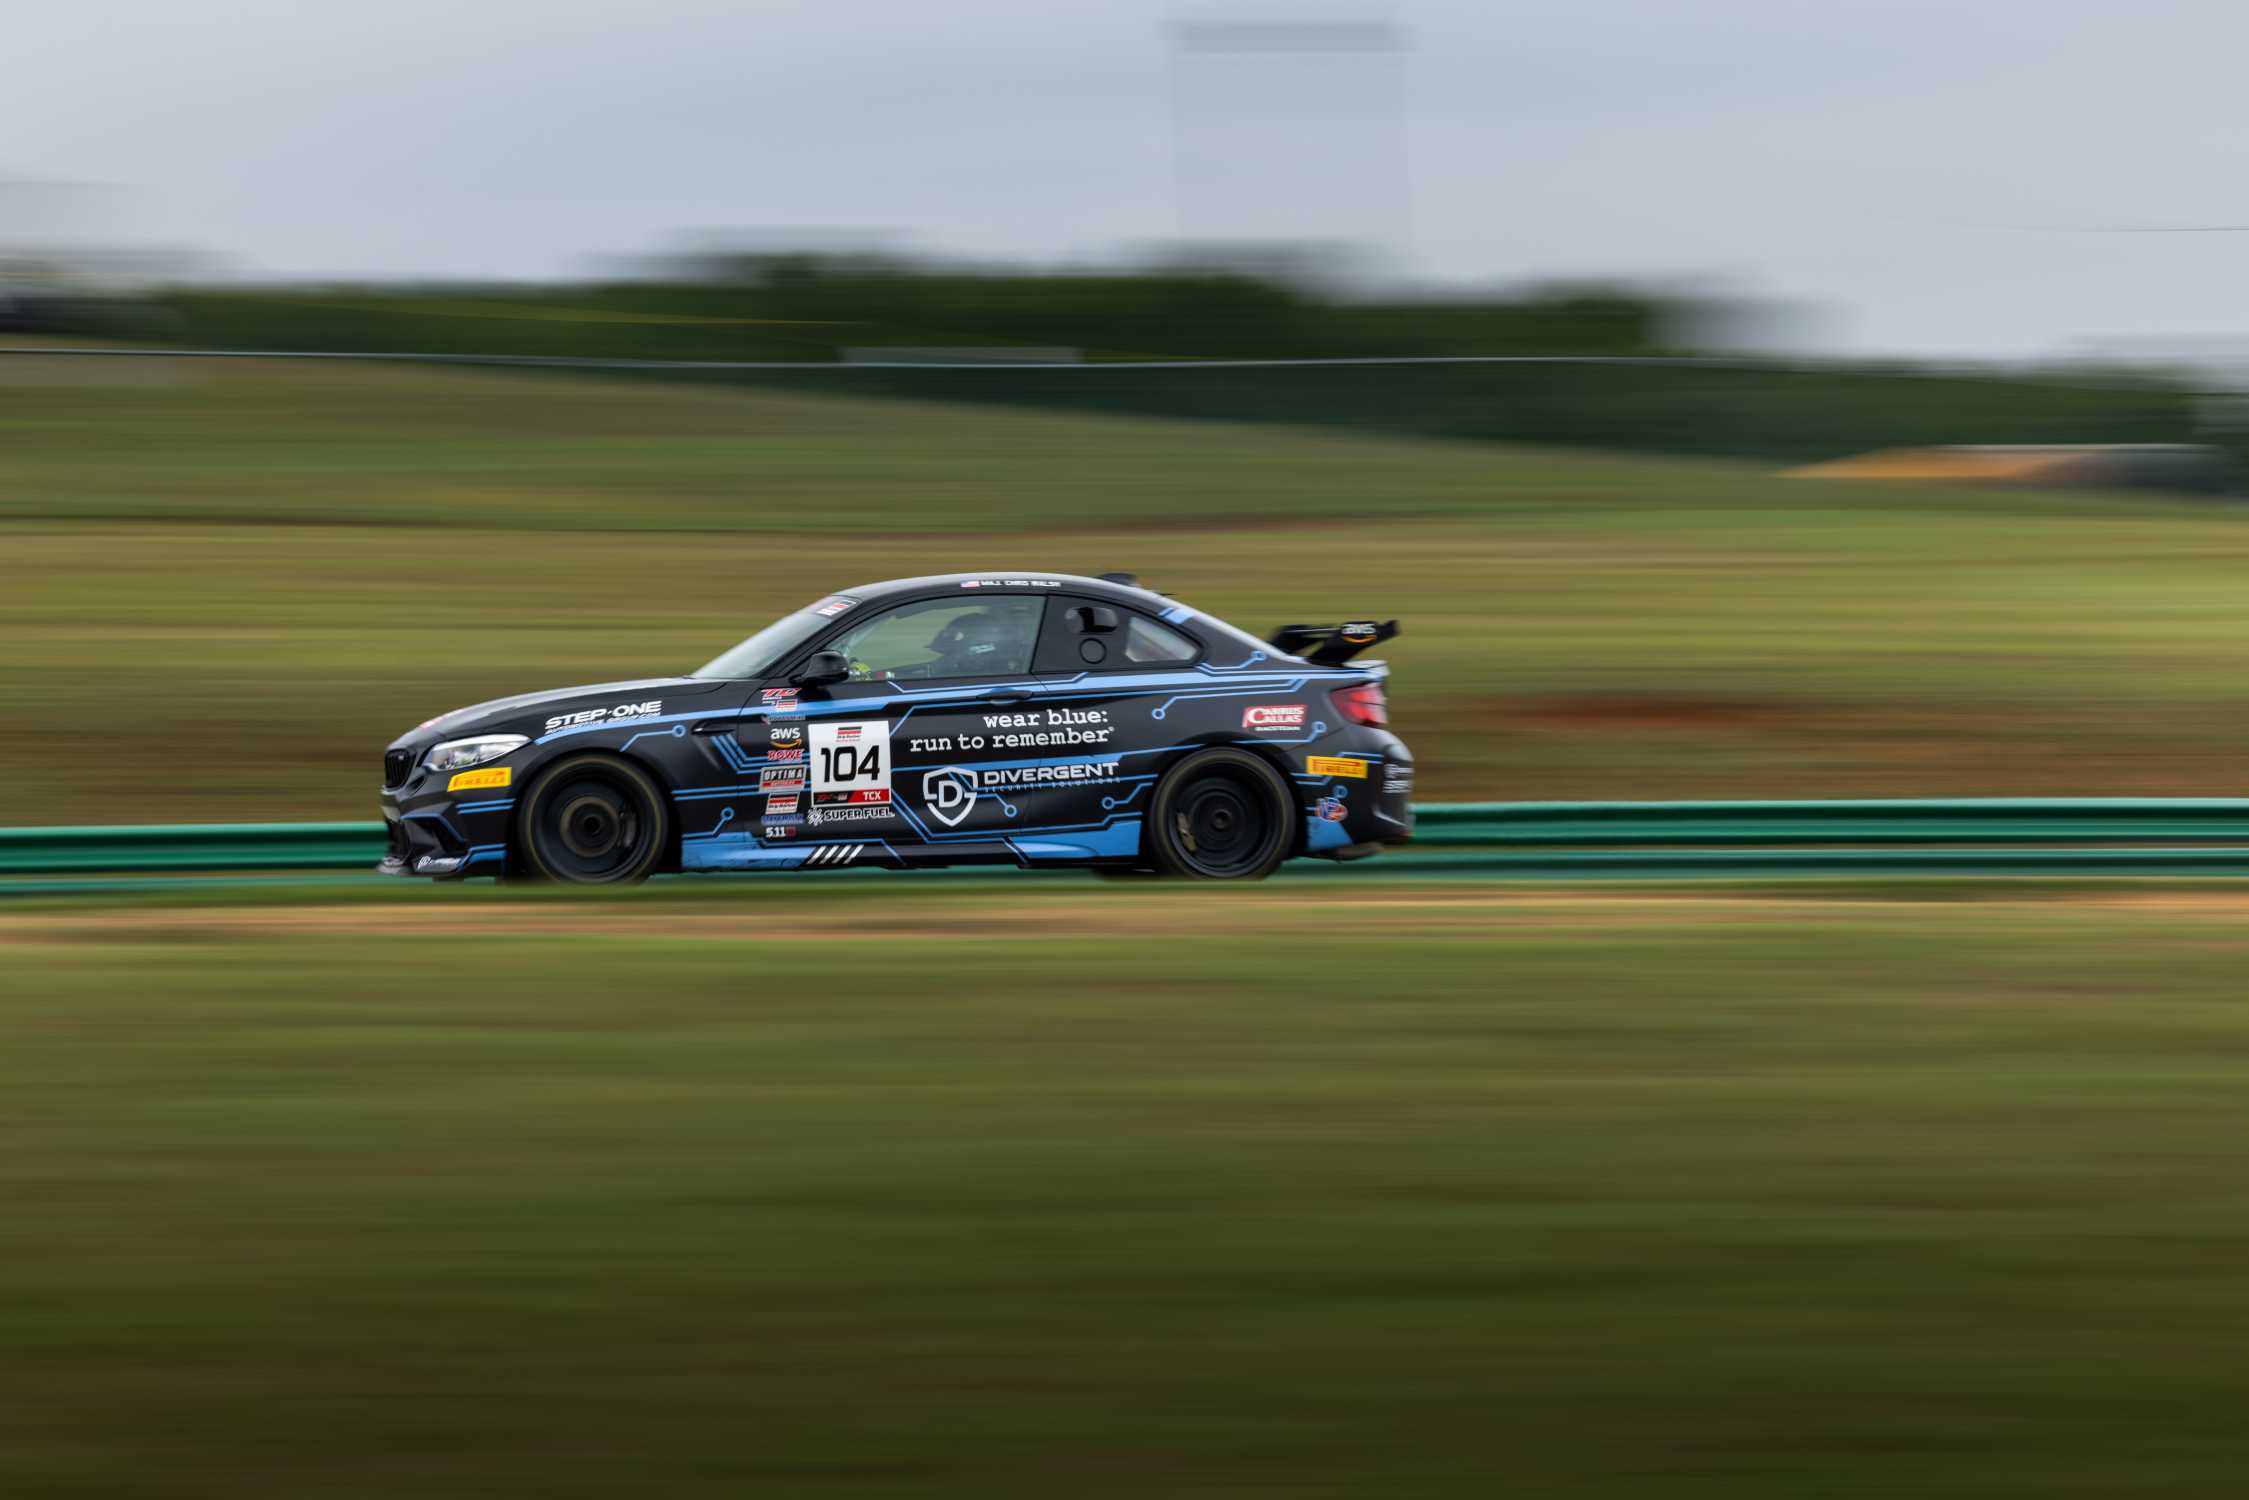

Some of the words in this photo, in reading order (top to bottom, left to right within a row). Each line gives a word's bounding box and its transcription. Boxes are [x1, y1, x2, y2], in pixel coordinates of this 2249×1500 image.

[984, 713, 1040, 728] wear
[1048, 709, 1109, 725] blue:
[770, 728, 801, 740] aws
[910, 737, 952, 752] run
[958, 733, 985, 749] to
[820, 745, 880, 782] 104
[764, 769, 803, 780] OPTIMA
[984, 762, 1119, 785] DIVERGENT
[863, 791, 882, 801] TCX
